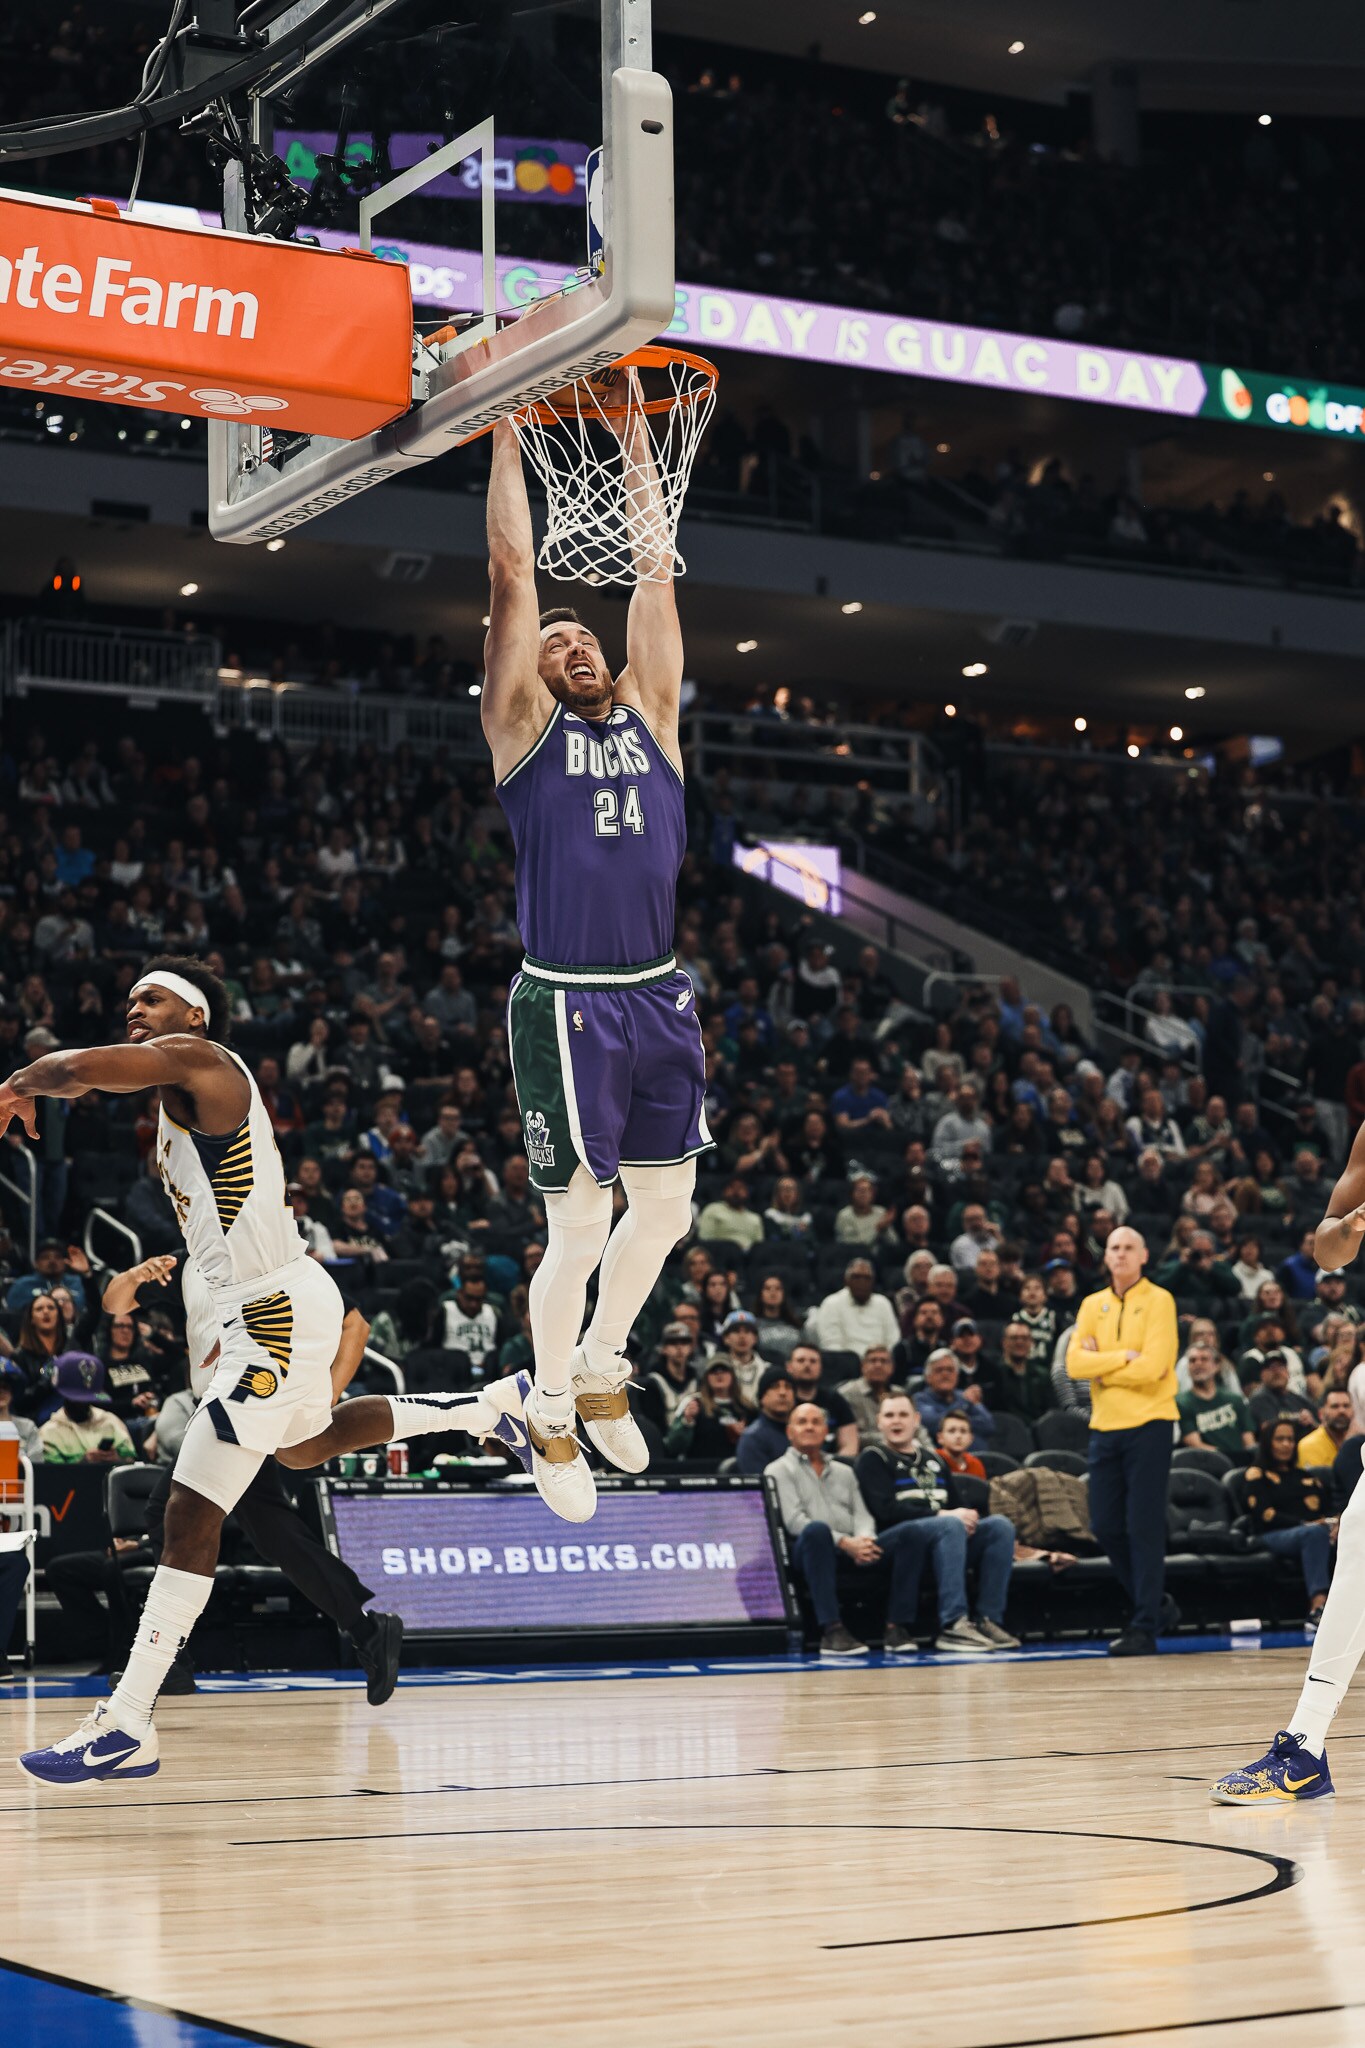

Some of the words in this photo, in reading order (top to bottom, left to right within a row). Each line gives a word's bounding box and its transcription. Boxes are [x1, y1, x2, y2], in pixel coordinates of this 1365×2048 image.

[0, 356, 187, 402] State
[834, 318, 871, 361] IS
[884, 322, 1050, 387] GUAC
[1076, 351, 1184, 407] DAY
[445, 350, 625, 436] SHOP.BUCKS.COM
[246, 466, 396, 538] SHOP.BUCKS.COM
[563, 726, 651, 779] BUCKS
[594, 785, 645, 836] 24
[382, 1542, 736, 1576] SHOP.BUCKS.COM
